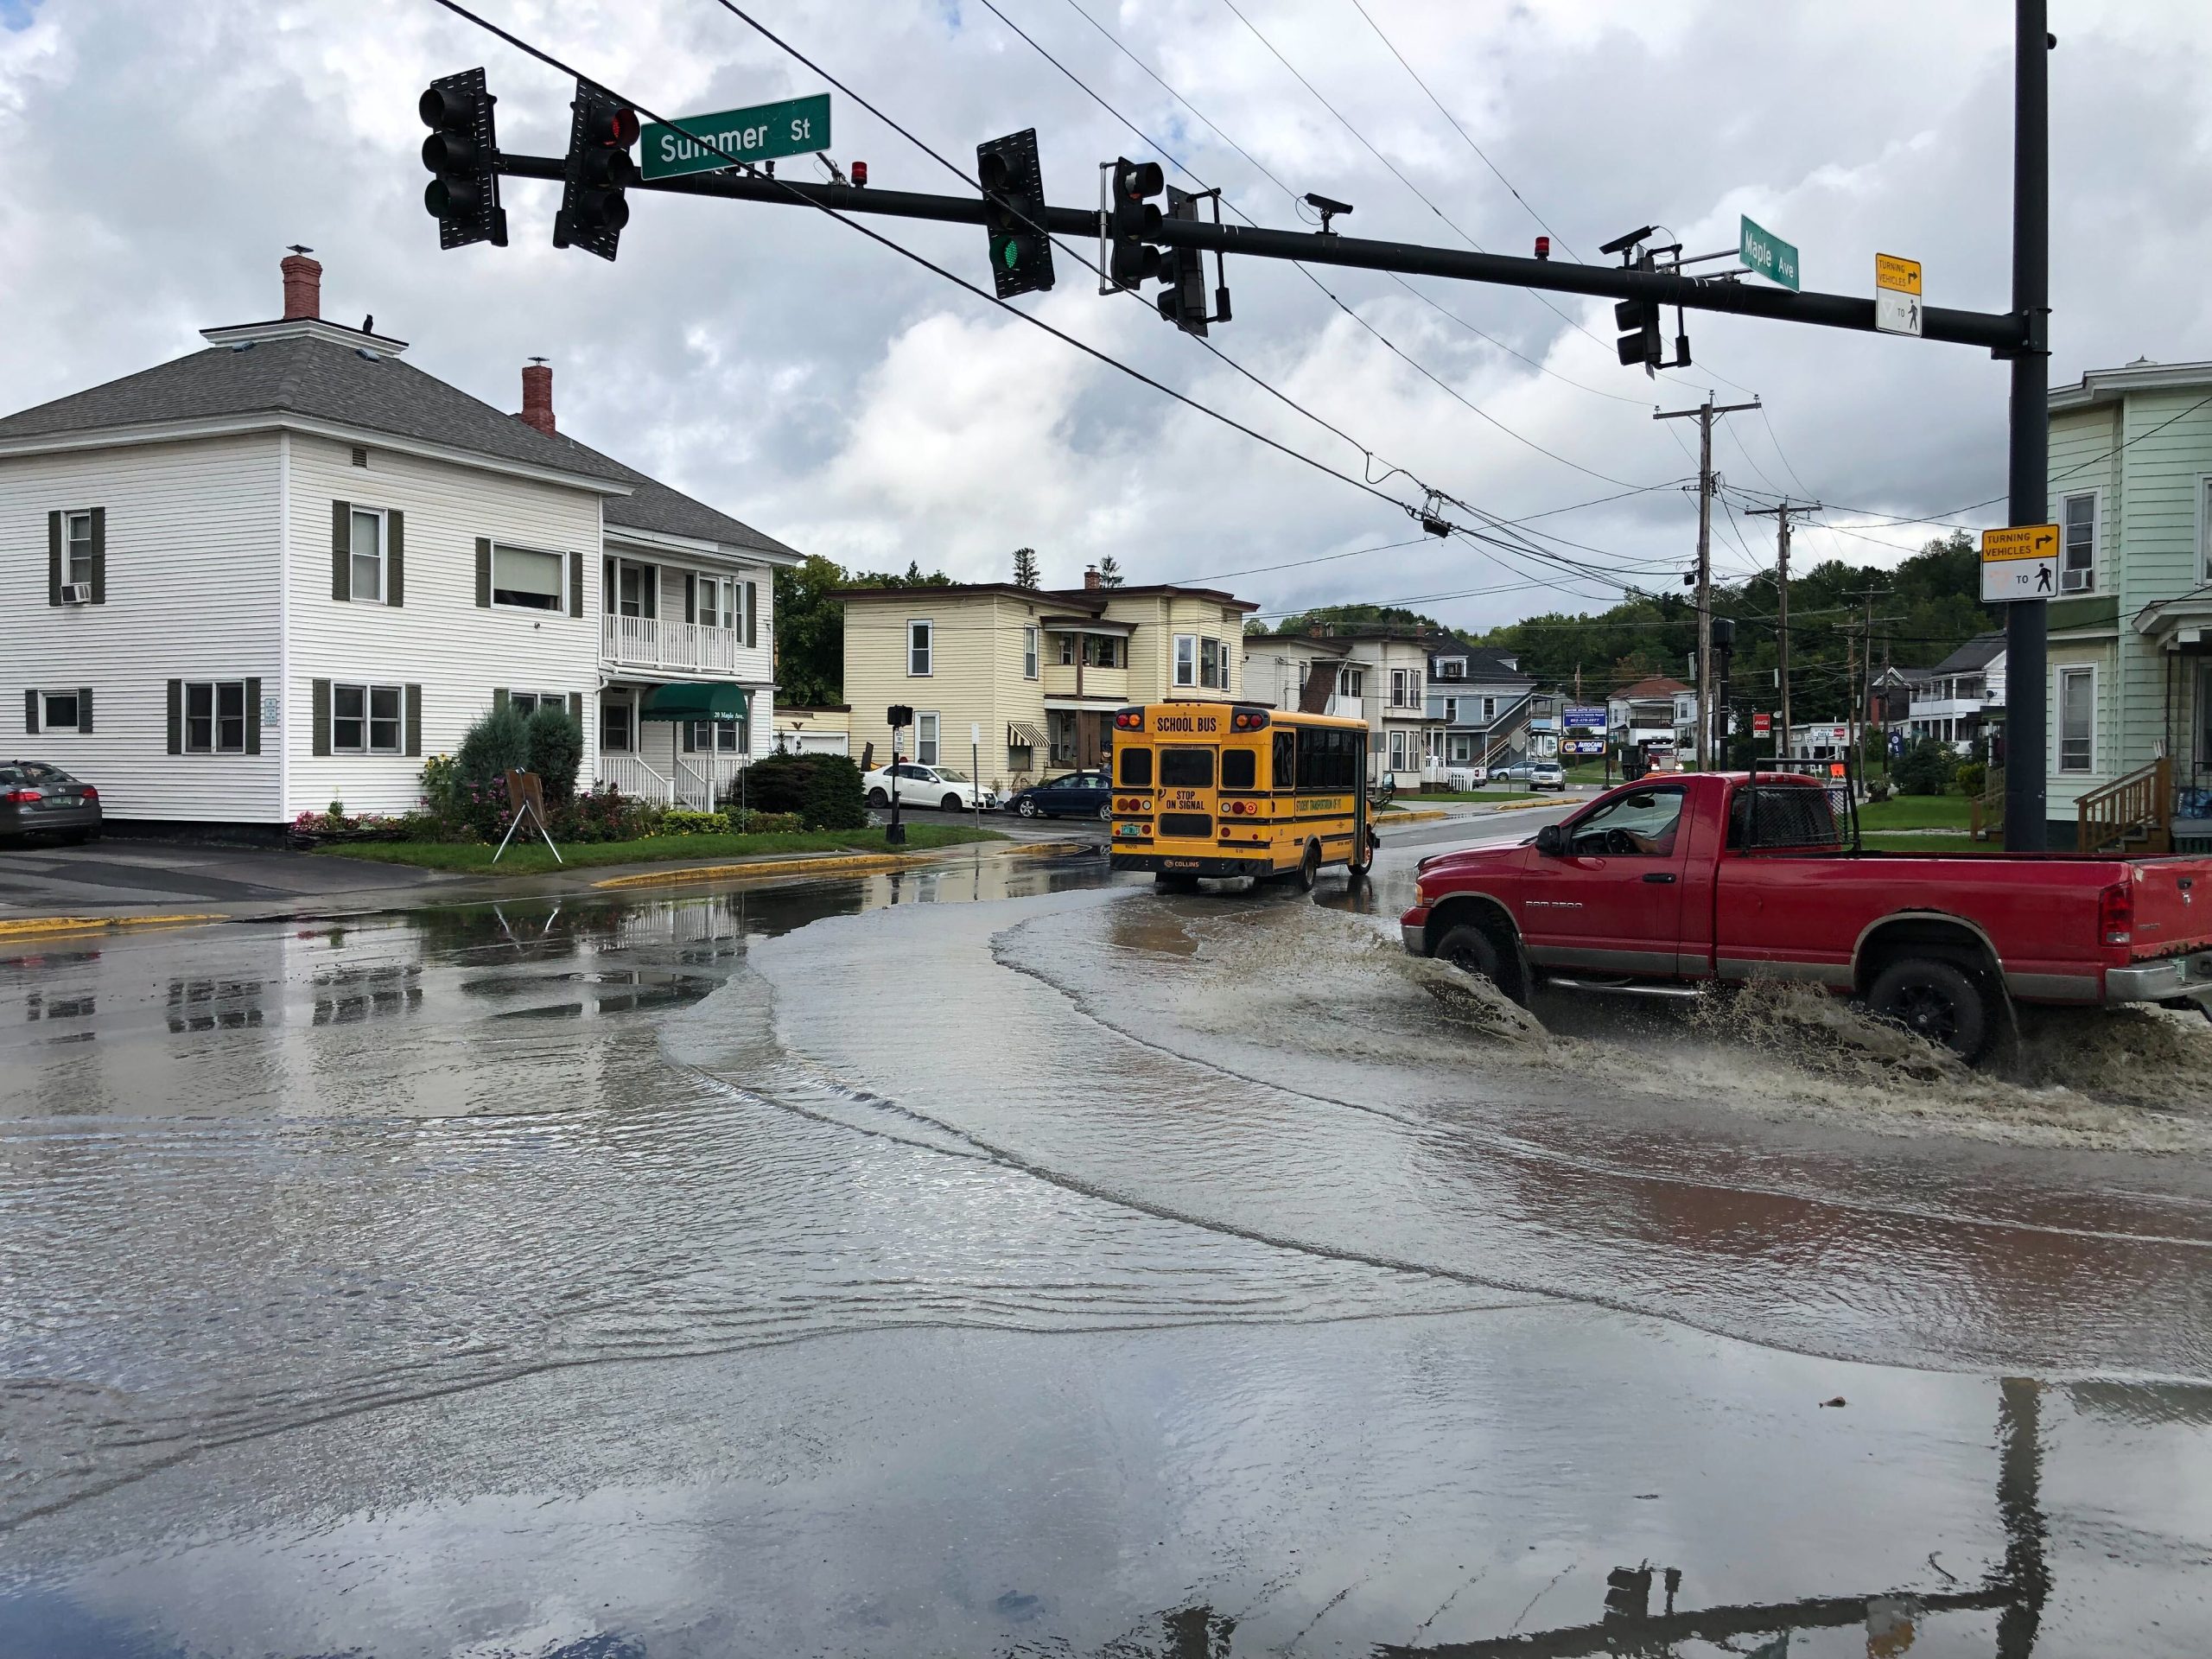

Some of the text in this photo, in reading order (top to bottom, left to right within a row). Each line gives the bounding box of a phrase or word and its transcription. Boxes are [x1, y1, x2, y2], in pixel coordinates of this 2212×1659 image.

[661, 118, 810, 162] Summer St
[1745, 230, 1794, 277] Maple Ave
[1878, 259, 1905, 274] TURNING
[1878, 273, 1906, 287] VEHICLES
[1897, 308, 1905, 318] TO
[1987, 532, 2031, 543] TURNING
[1986, 545, 2031, 556] VEHICLES
[2016, 575, 2029, 584] TO
[721, 711, 734, 720] Maple
[1157, 717, 1217, 732] SCHOOL BUS
[1176, 791, 1196, 800] STOP
[1166, 800, 1205, 810] ON SIGNAL
[1296, 799, 1309, 812] STUDENT
